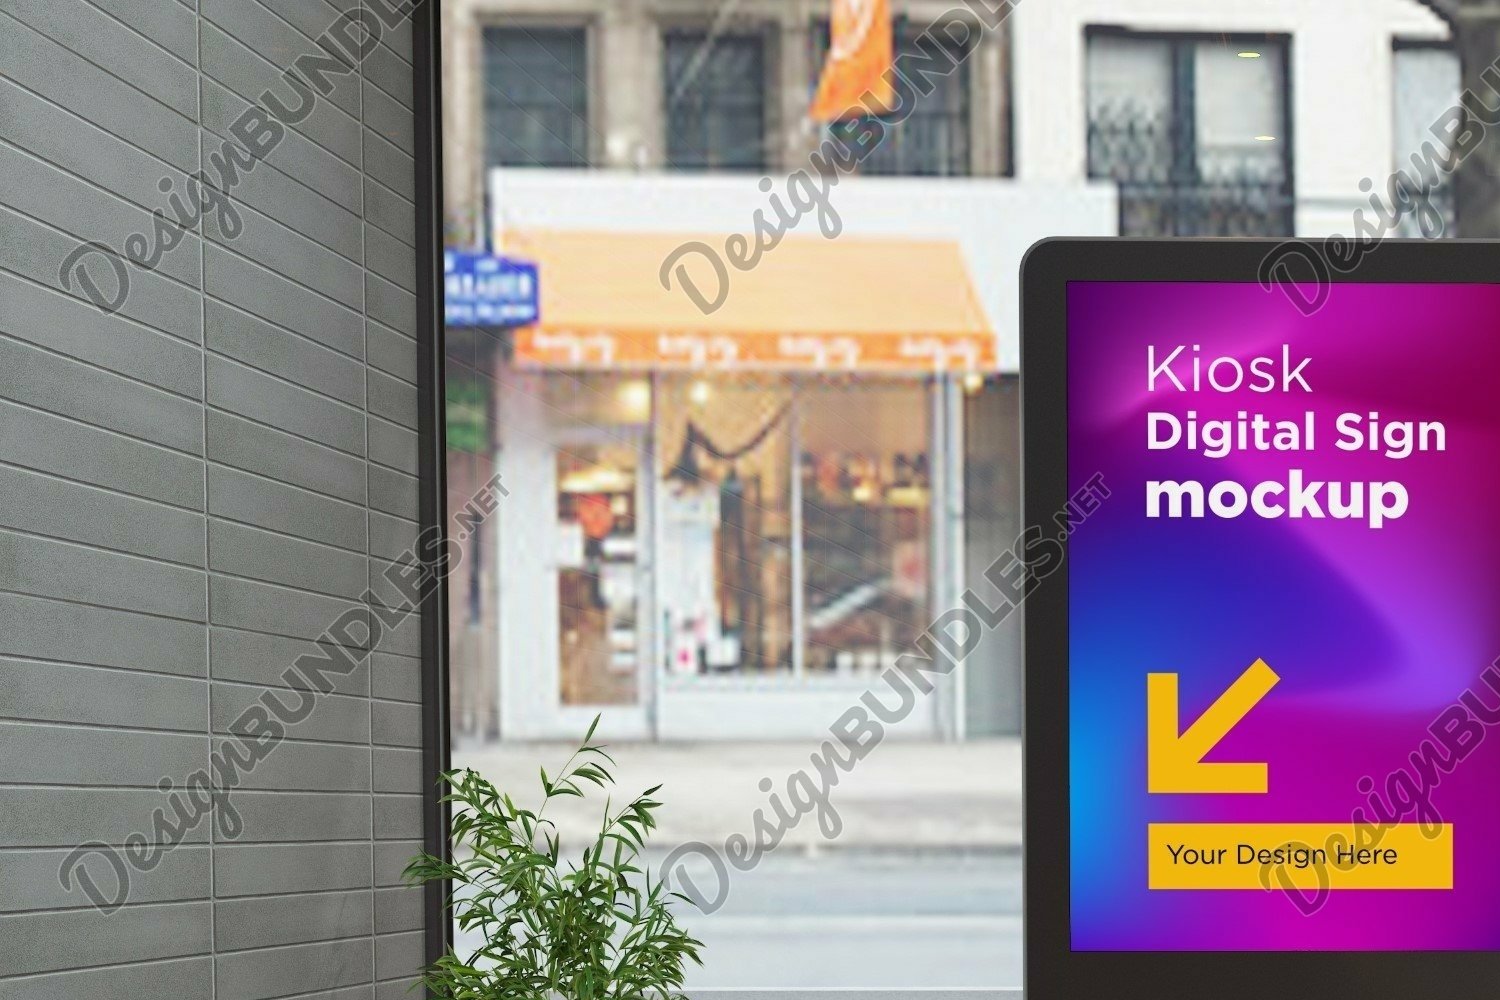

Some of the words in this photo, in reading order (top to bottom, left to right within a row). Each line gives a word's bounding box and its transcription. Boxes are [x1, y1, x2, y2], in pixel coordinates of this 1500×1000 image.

[1147, 343, 1313, 394] Kiosk
[1146, 410, 1315, 459] Digital
[1334, 410, 1447, 459] Sign
[1146, 469, 1409, 529] mockup
[1166, 844, 1227, 865] Your
[1236, 843, 1327, 869] Design
[1336, 844, 1398, 865] Here
